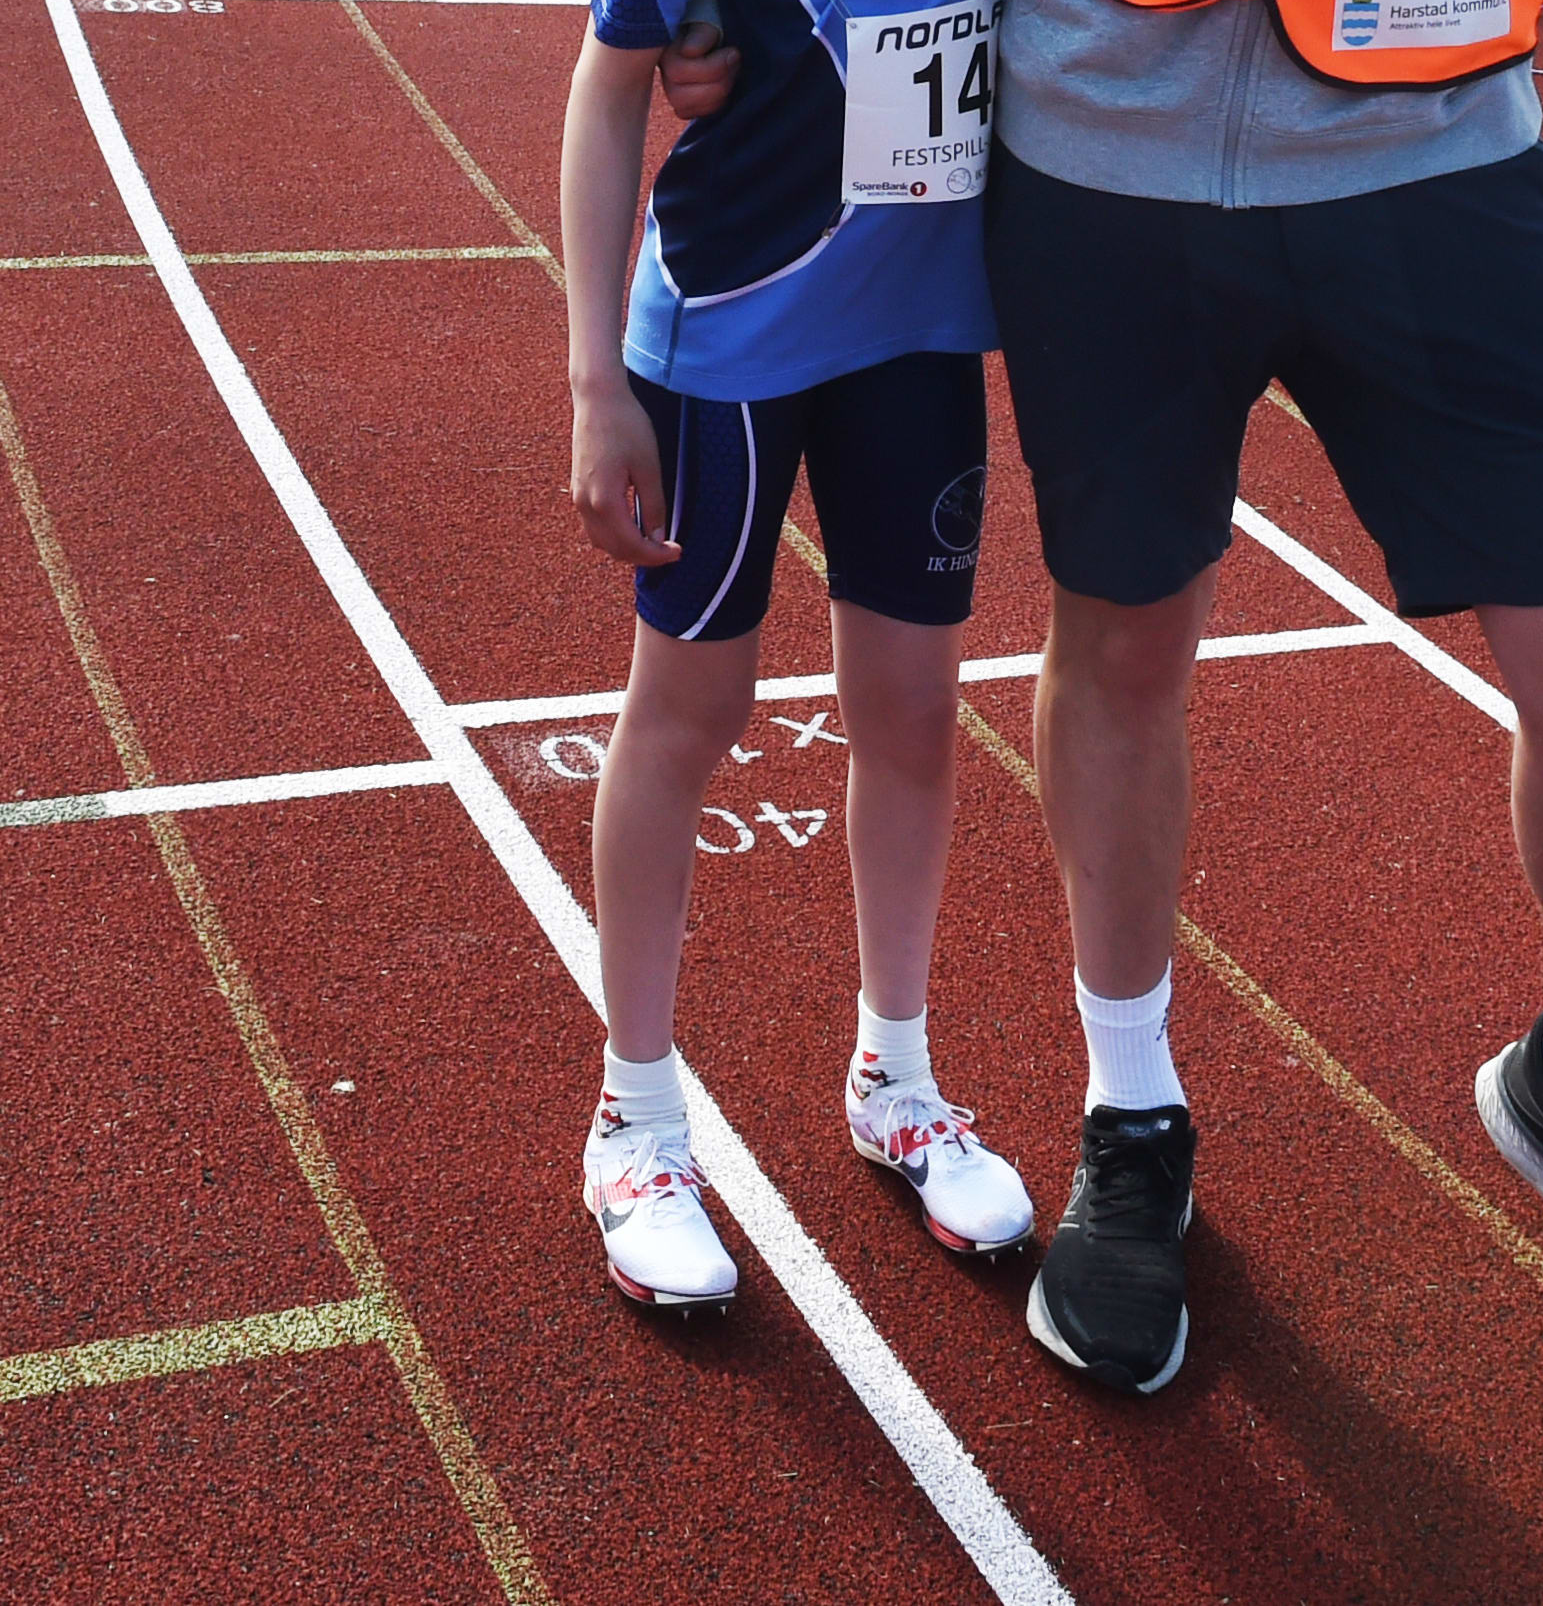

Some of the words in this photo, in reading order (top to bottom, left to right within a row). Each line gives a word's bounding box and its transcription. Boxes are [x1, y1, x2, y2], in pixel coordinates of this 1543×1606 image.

[1390, 1, 1448, 19] Harstad
[913, 40, 993, 138] 14
[892, 136, 988, 167] FESTSPILL
[852, 181, 909, 192] SpareBank
[926, 557, 948, 572] IK
